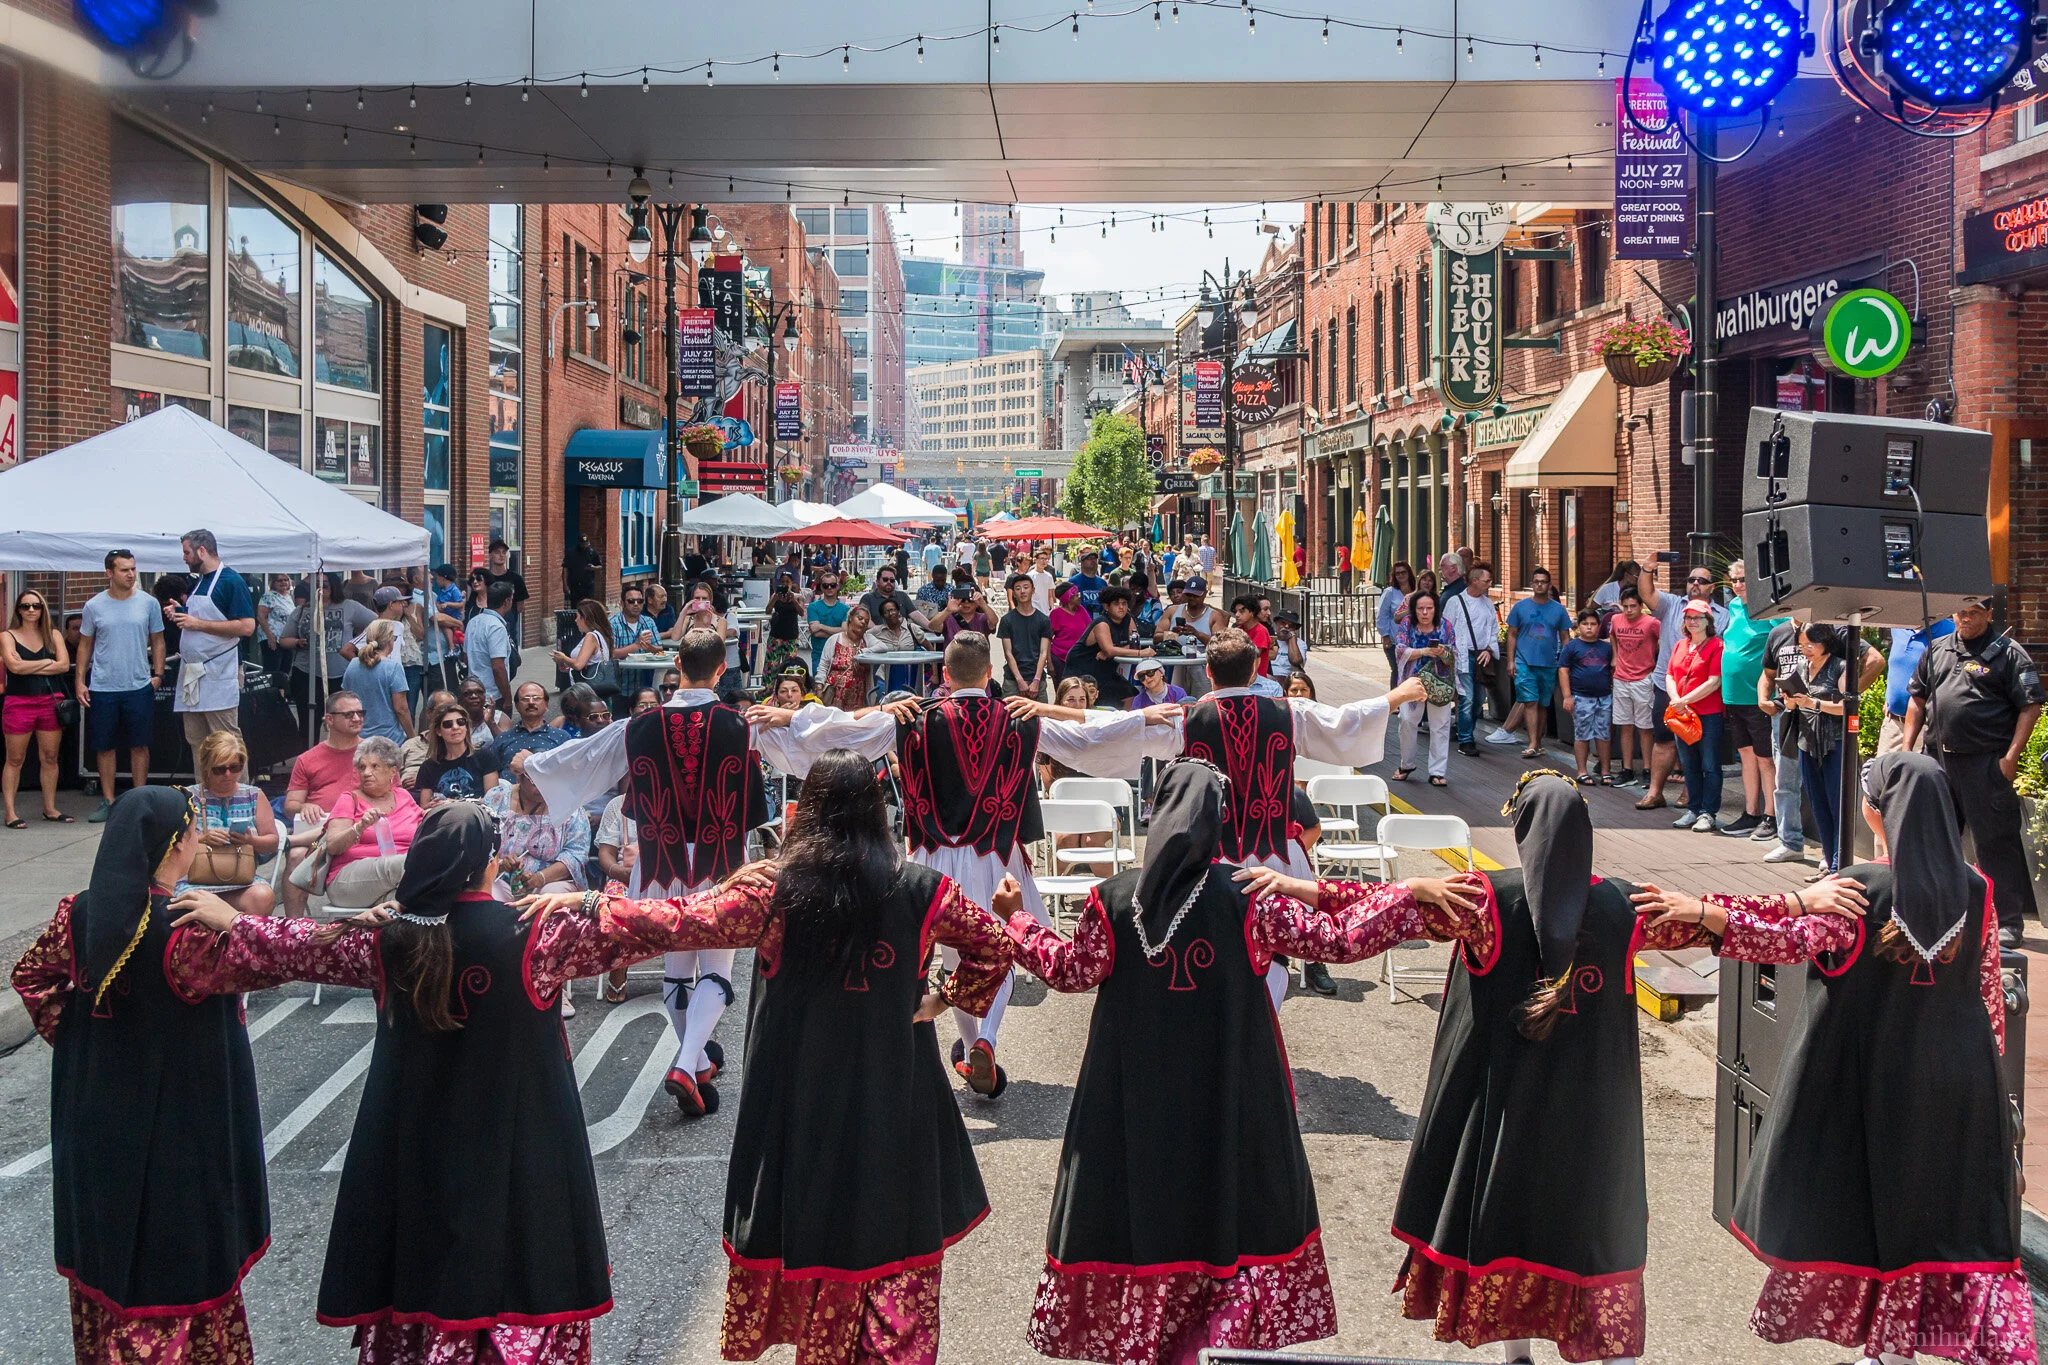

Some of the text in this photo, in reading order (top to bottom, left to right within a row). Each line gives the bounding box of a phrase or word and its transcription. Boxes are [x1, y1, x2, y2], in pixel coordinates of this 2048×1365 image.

[1628, 99, 1668, 110] REEKTO
[1622, 132, 1682, 150] Festival
[1621, 164, 1682, 178] JULY 27
[1620, 203, 1683, 212] GREAT FOOD,
[1618, 214, 1685, 223] GREAT DRINKS
[1457, 211, 1490, 246] ST
[1647, 225, 1655, 234] &
[1623, 236, 1680, 245] GREAT TIME!
[723, 279, 733, 341] CASIN
[1716, 279, 1839, 340] wahlburgers
[1450, 260, 1471, 382] STEAK
[248, 316, 284, 339] MOTOWN
[683, 326, 712, 337] Heritage
[683, 335, 712, 345] Festival
[1471, 273, 1493, 395] HOUSE
[683, 350, 702, 358] JULY
[1249, 365, 1281, 393] PAPALIS
[1236, 394, 1268, 406] PIZZA
[1232, 403, 1277, 422] TAVERNA
[832, 446, 874, 454] COLD STONE
[876, 449, 897, 457] UYS
[578, 461, 623, 473] PEGASUS
[587, 473, 615, 481] TAVERNA
[1164, 478, 1195, 490] GREEK
[1617, 627, 1644, 635] NAUTICA
